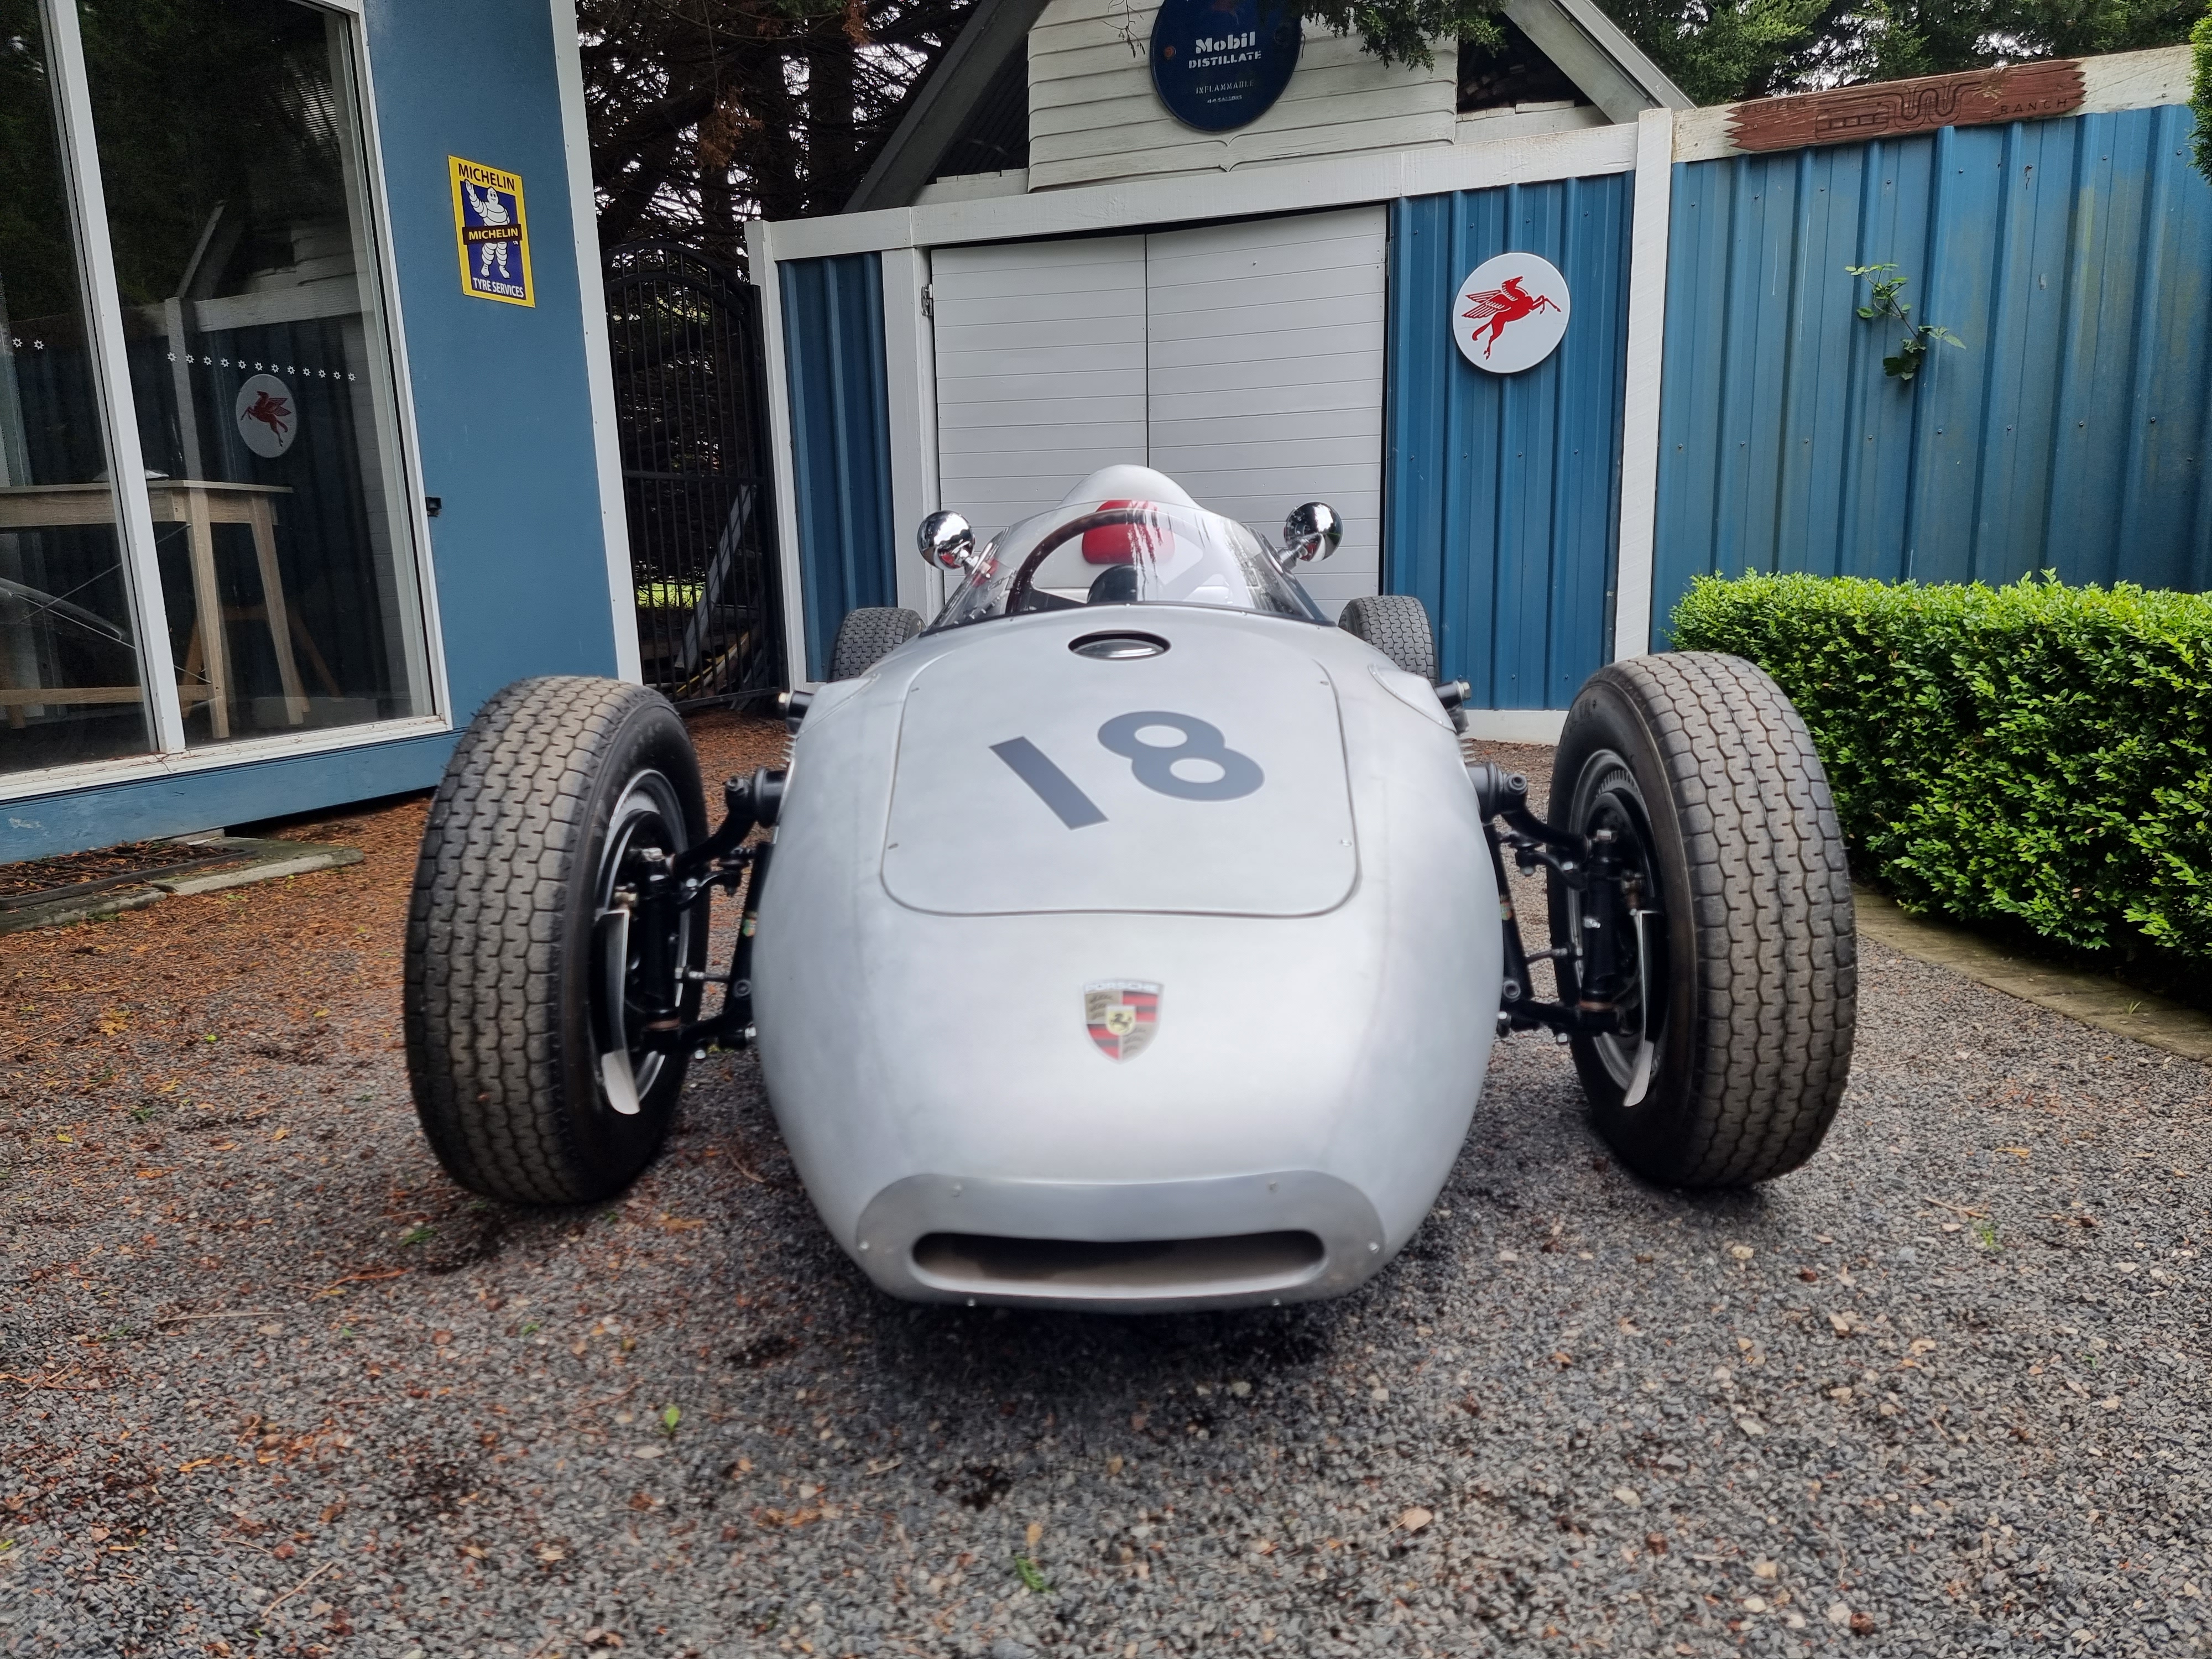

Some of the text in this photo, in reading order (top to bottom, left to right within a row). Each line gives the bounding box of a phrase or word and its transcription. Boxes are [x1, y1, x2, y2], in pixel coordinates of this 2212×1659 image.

[1196, 31, 1255, 54] Mobil
[1188, 50, 1262, 69] DISTILLATE
[1196, 79, 1254, 95] INFLAMMABLE
[2000, 98, 2068, 114] RANCH
[458, 163, 515, 191] MICHELIN
[468, 227, 519, 241] MICHELIN
[473, 277, 524, 298] TYRE SERVICES
[989, 711, 1266, 831] 18
